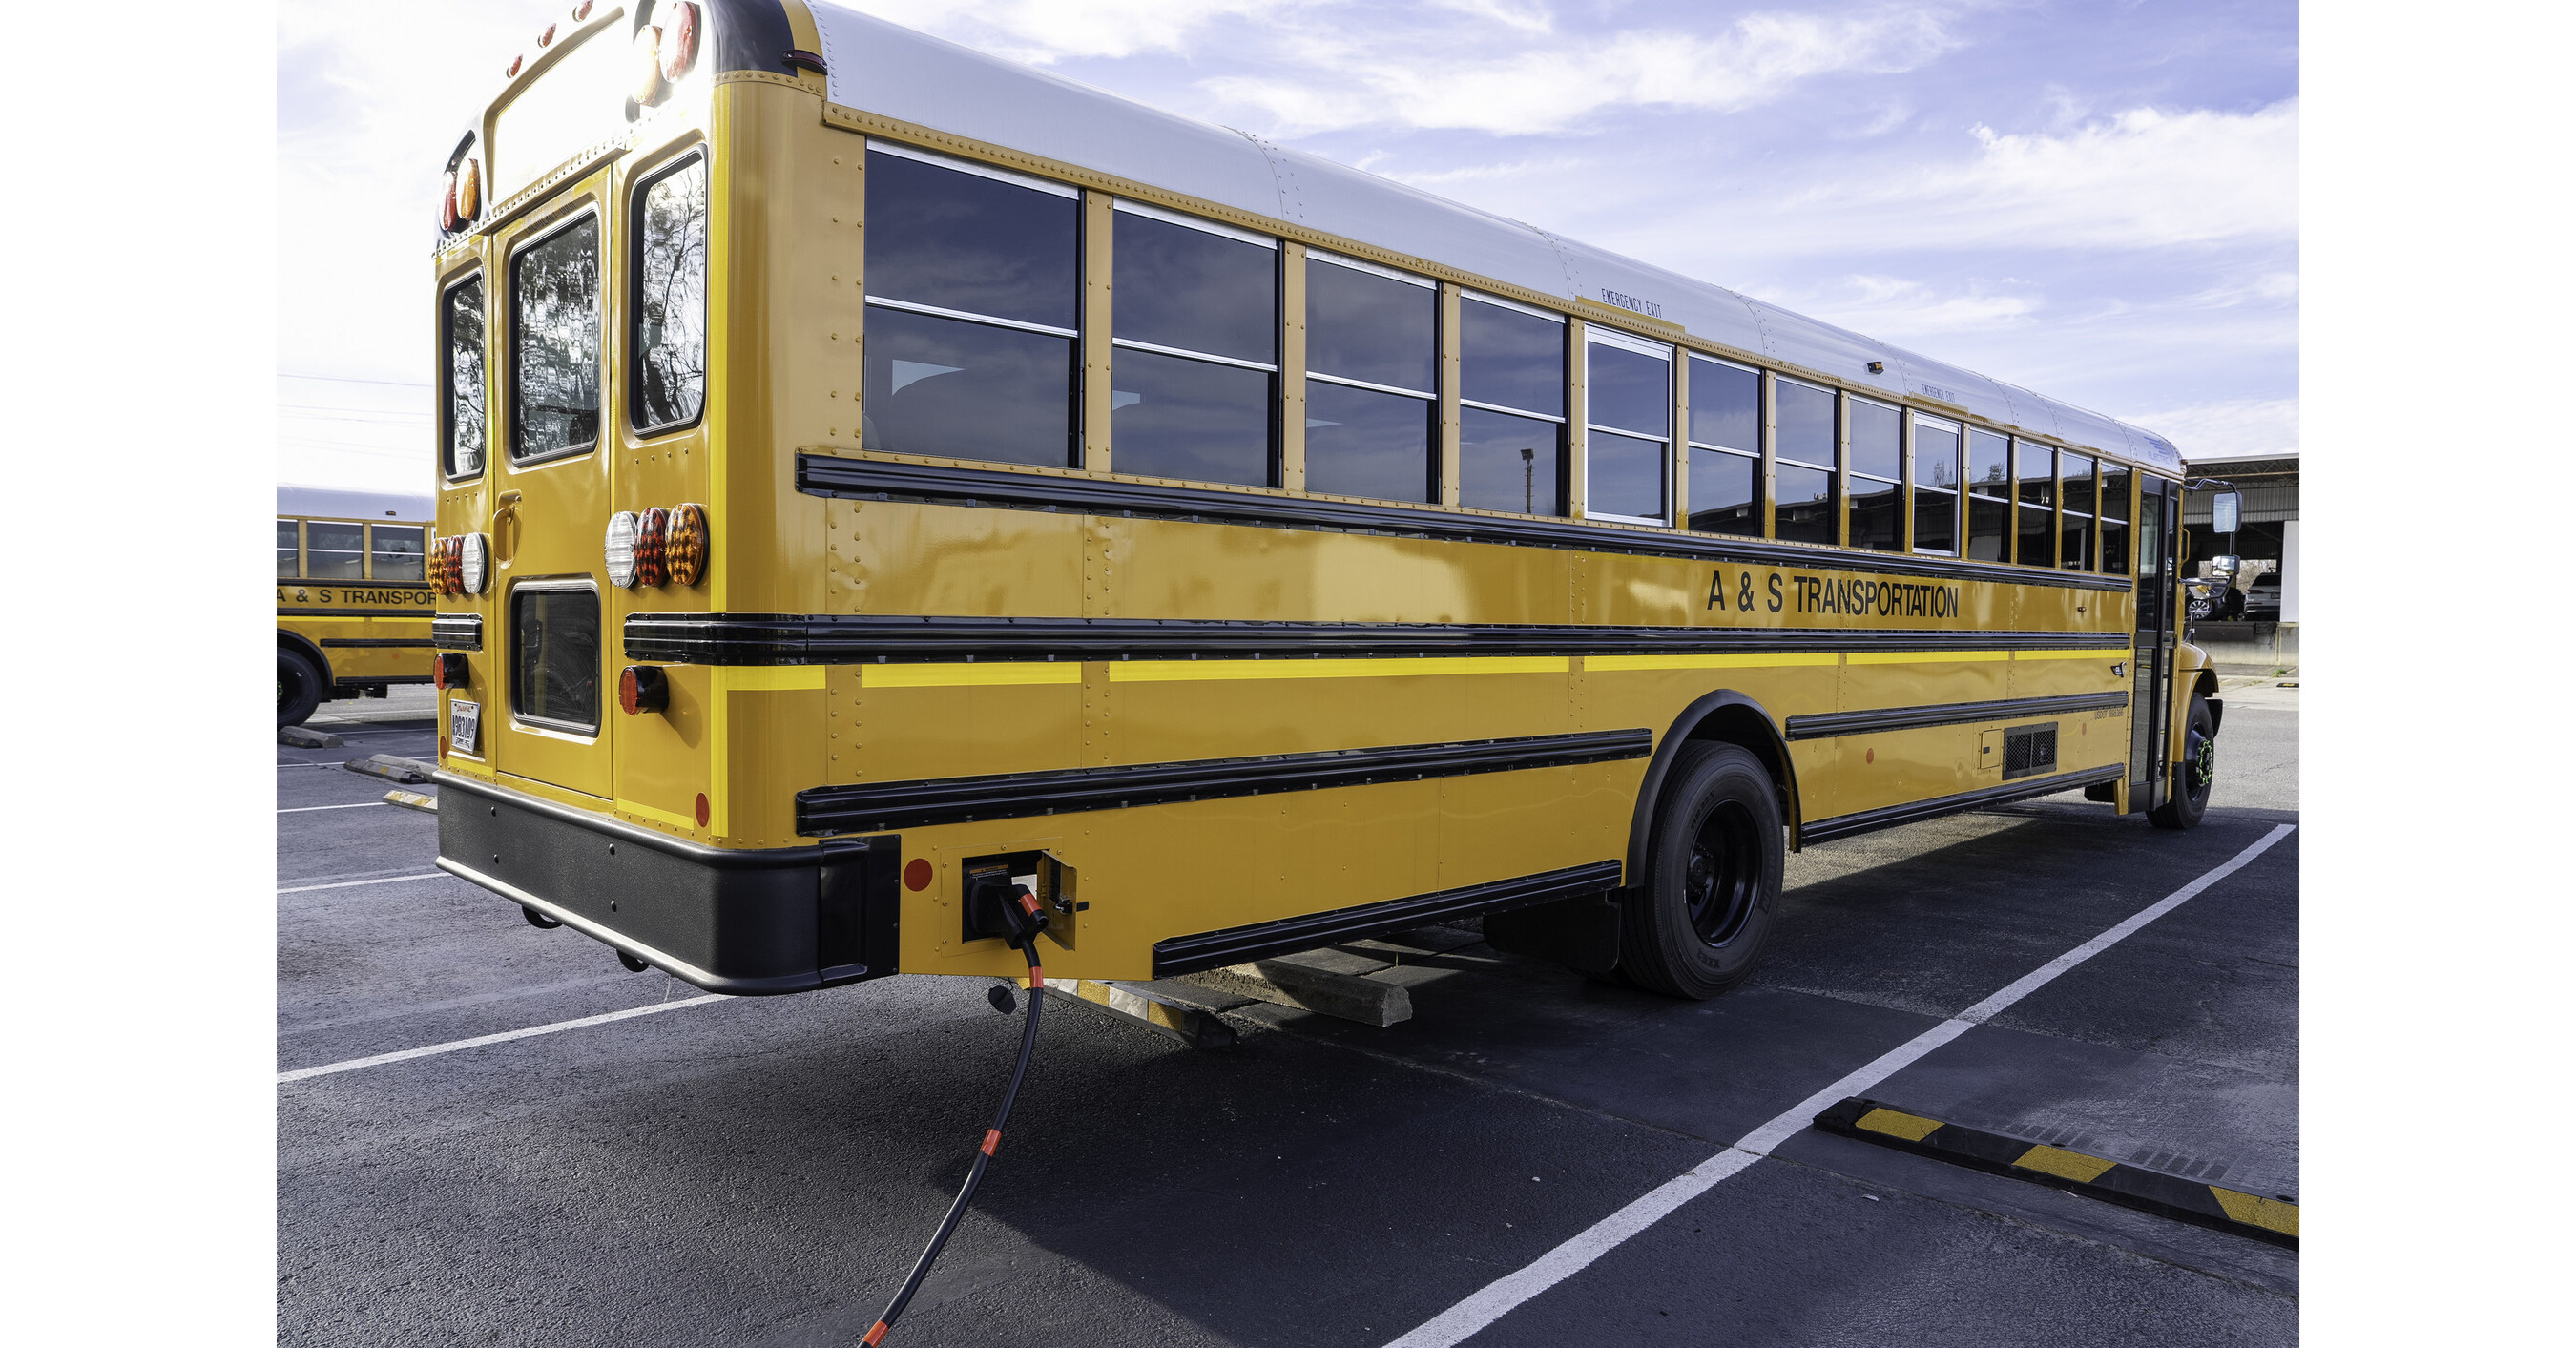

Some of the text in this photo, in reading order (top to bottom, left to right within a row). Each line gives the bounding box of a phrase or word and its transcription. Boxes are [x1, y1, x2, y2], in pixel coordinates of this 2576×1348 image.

[1601, 288, 1662, 318] EMERGENCY EXIT
[1921, 383, 1955, 403] EMERGENCY EXIT
[296, 589, 309, 603] &
[319, 589, 332, 603] S
[1707, 570, 1958, 618] A & S TRANSPORTATION
